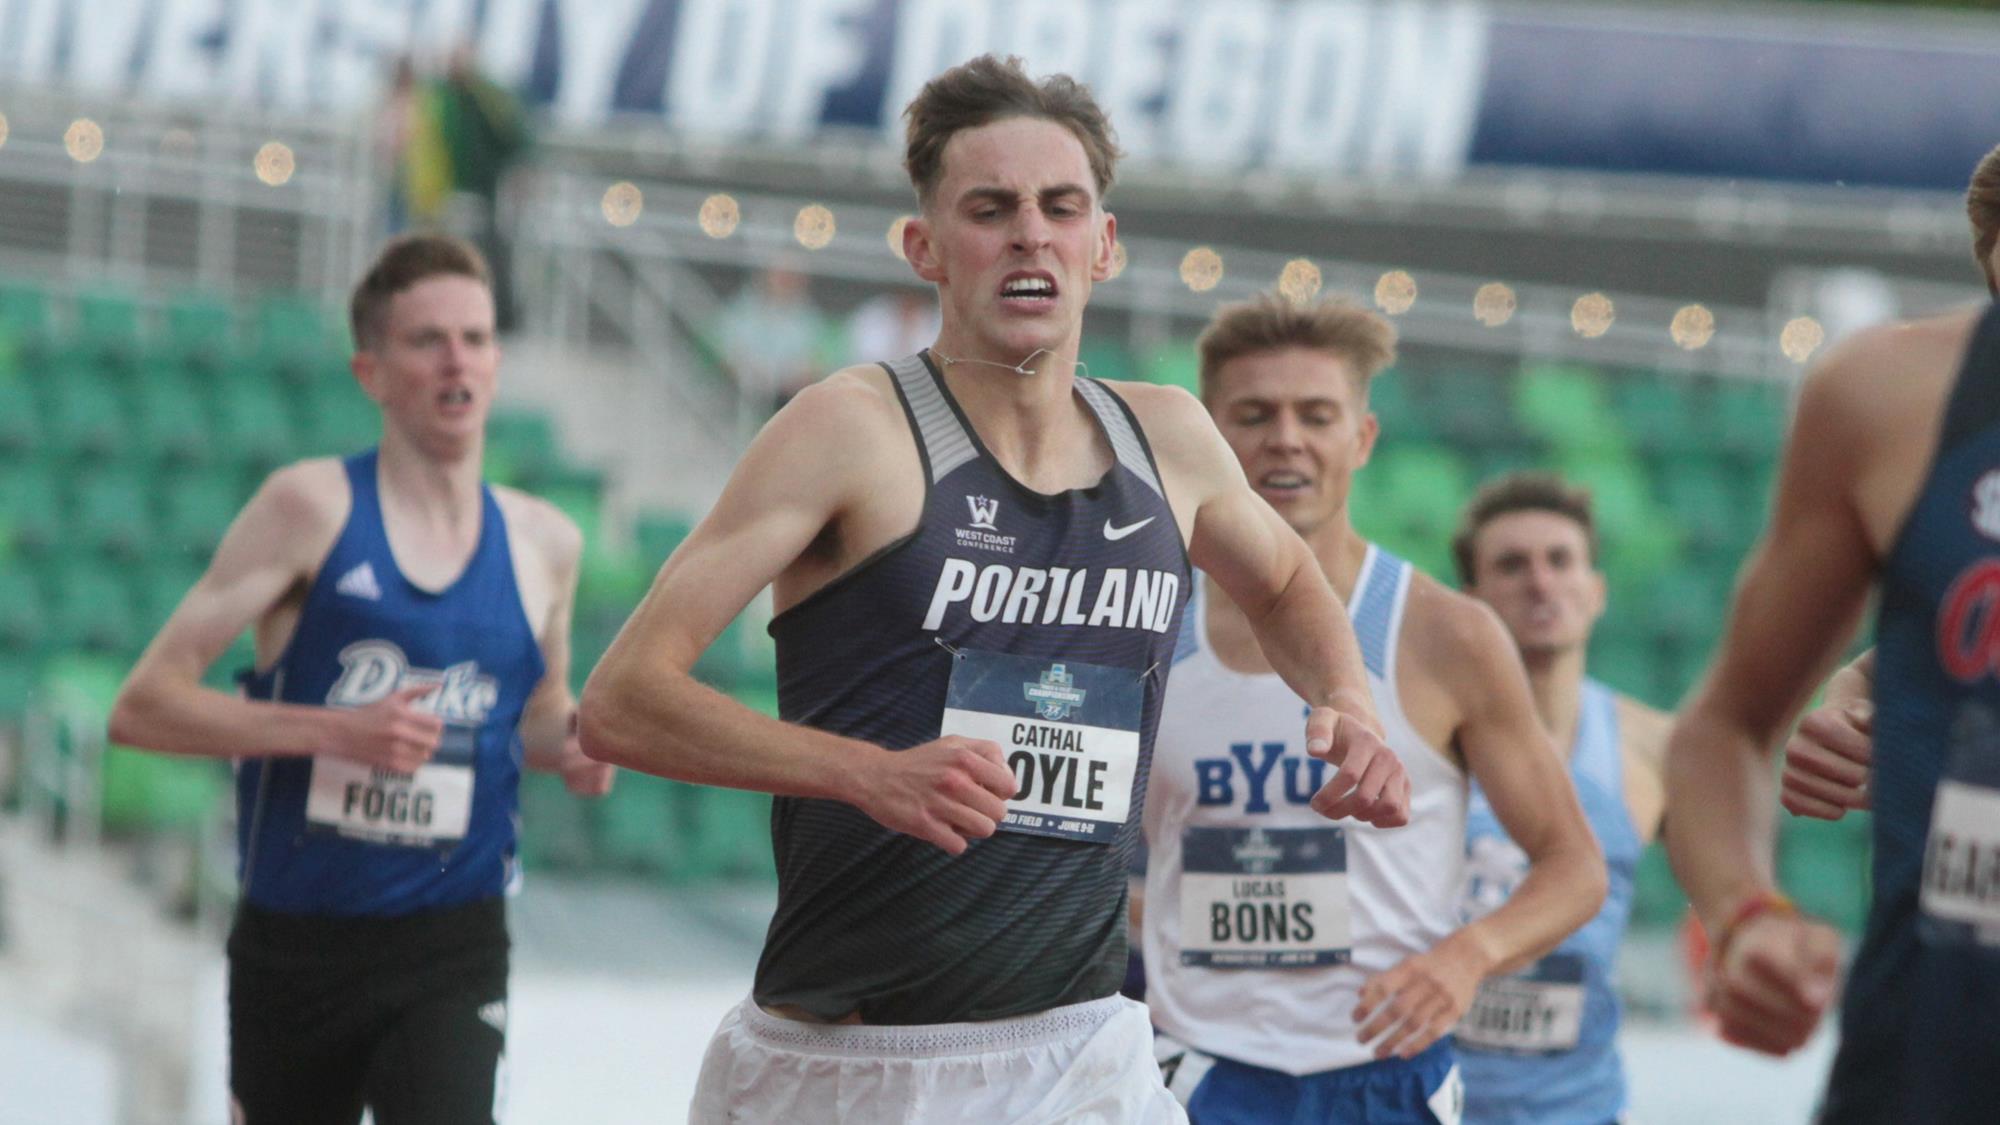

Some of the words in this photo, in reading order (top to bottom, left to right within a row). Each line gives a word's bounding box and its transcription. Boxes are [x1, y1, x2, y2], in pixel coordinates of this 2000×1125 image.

[955, 528, 983, 541] WEST
[983, 533, 1017, 546] COAST
[957, 539, 1015, 554] CONFERENCE
[921, 558, 1179, 633] PORTLAND
[1012, 723, 1084, 752] CATHAL
[1194, 743, 1327, 814] BYU
[344, 782, 434, 827] FOGG
[1018, 814, 1043, 827] FIELD
[1058, 820, 1080, 832] JUNE
[1232, 880, 1285, 899] LUCAS
[1211, 902, 1315, 943] BONS
